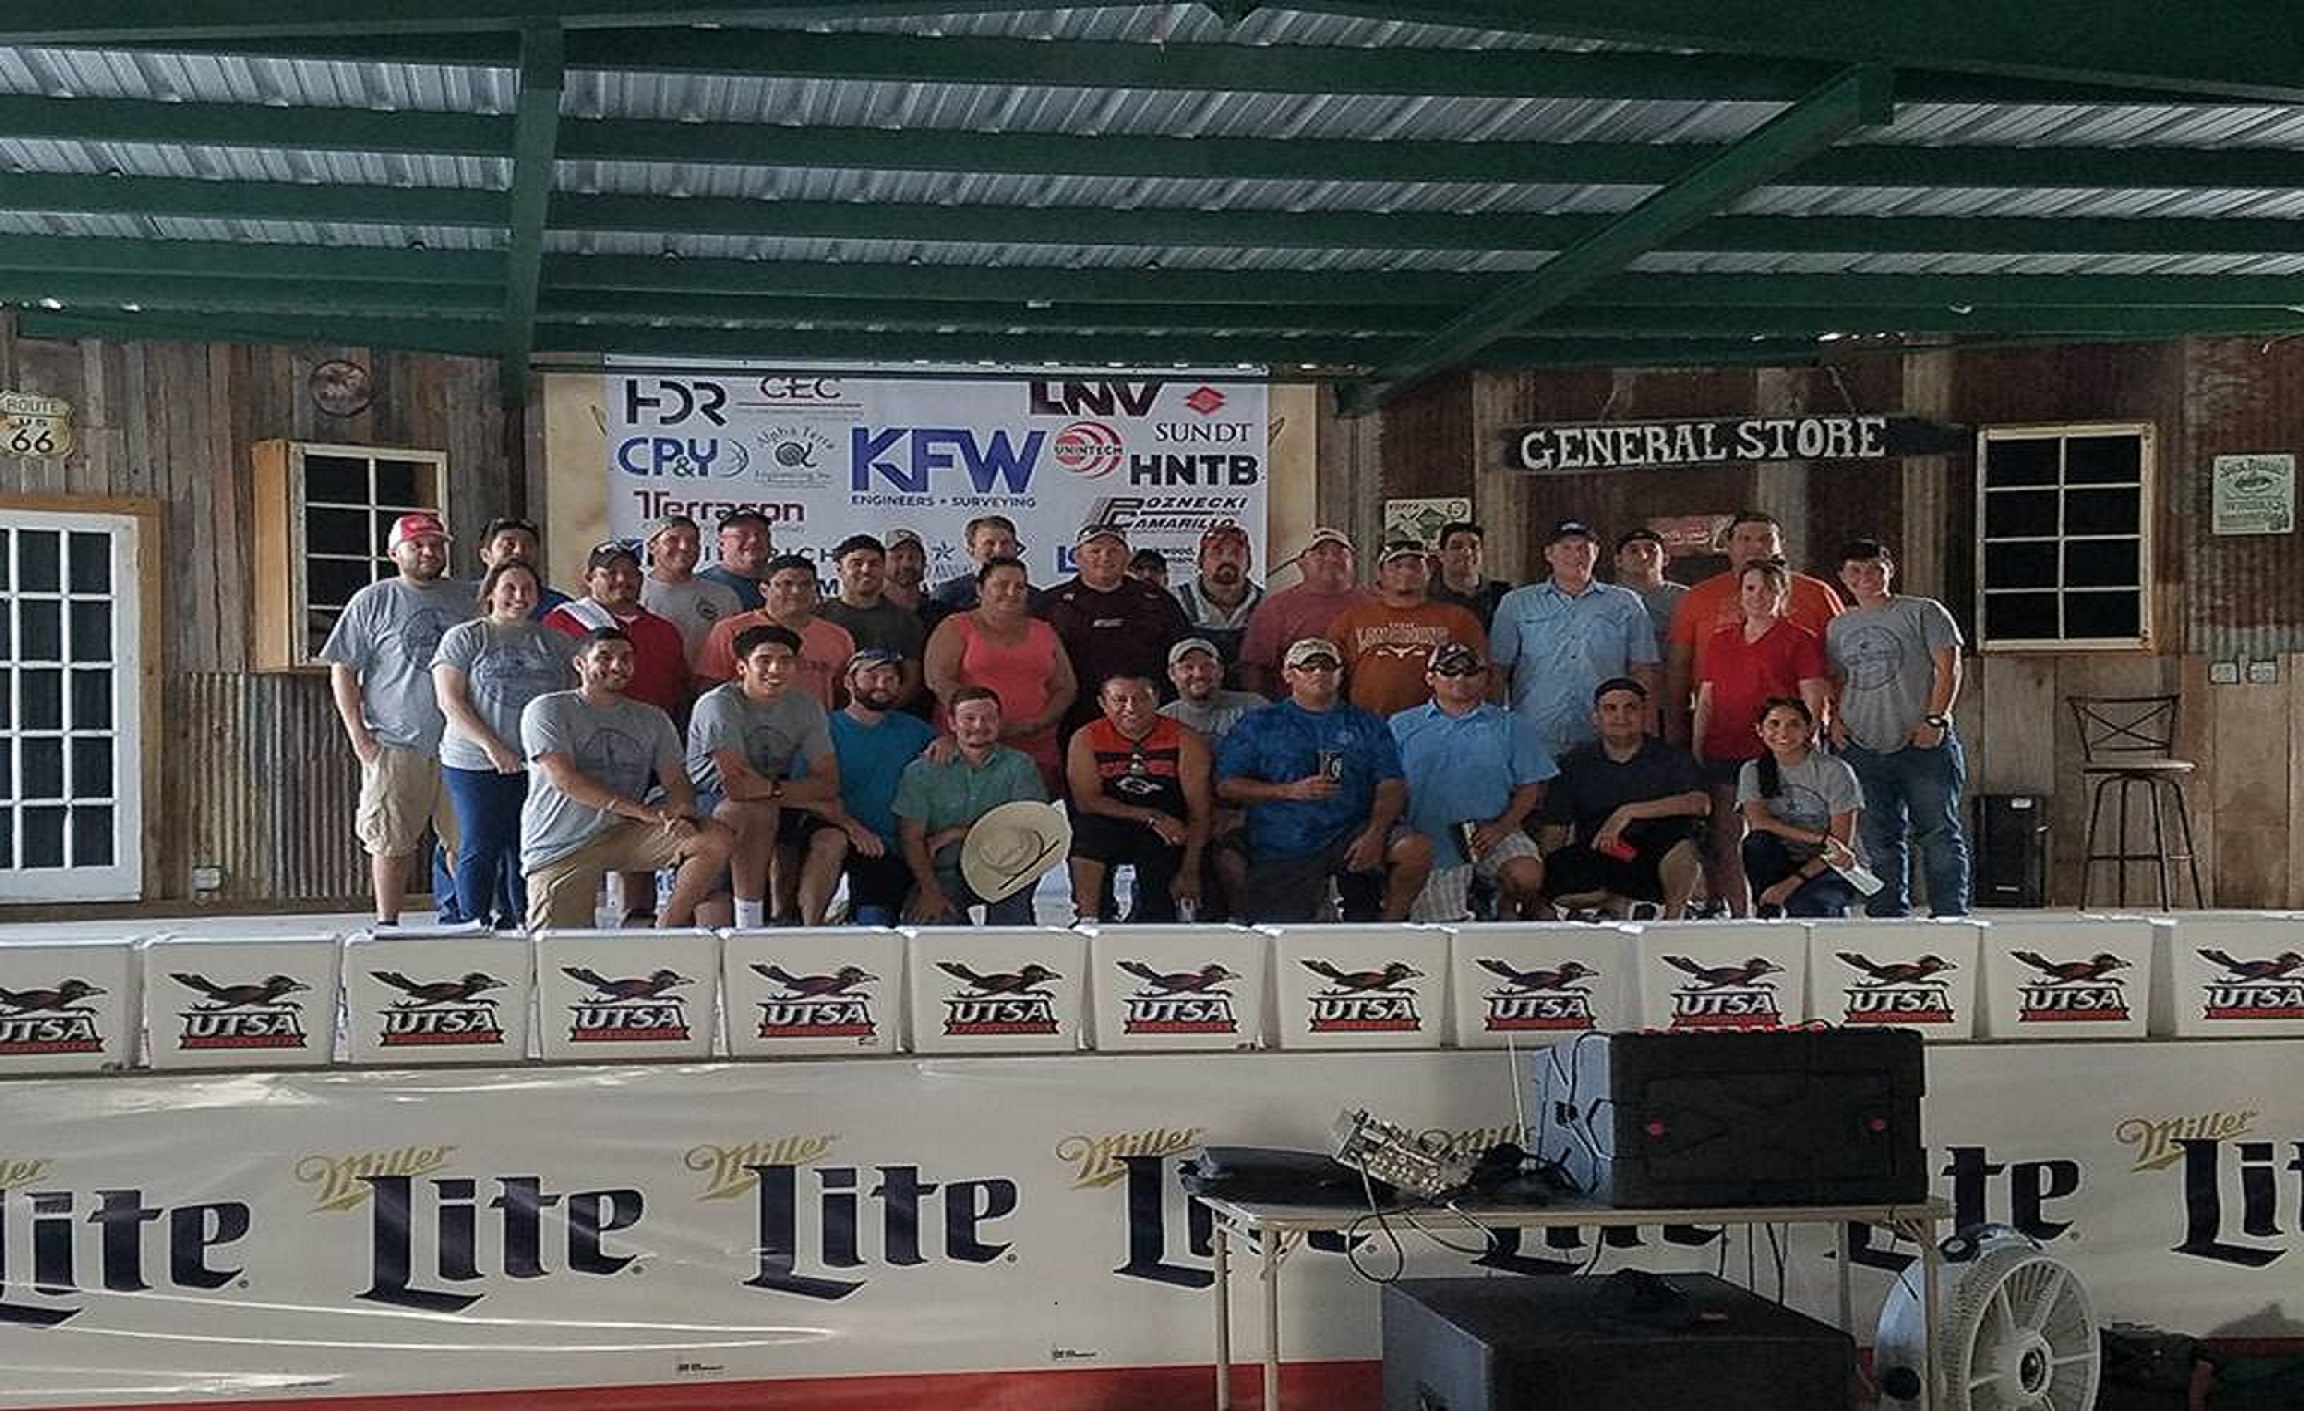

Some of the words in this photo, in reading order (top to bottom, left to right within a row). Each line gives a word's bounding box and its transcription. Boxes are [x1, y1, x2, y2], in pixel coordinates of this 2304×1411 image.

[6, 398, 59, 413] ROUTE
[626, 379, 728, 427] HDR
[1029, 381, 1163, 416] LNV
[12, 429, 54, 453] 66
[1156, 423, 1252, 442] SUNDT
[1521, 425, 1726, 470] GENERAL
[1736, 416, 1887, 460] STORE
[851, 427, 1046, 494] KFW
[1129, 455, 1258, 486] HNTB
[851, 495, 935, 506] ENGINEERS
[951, 496, 1036, 508] SURVEYING
[1492, 999, 1592, 1018] UTSA
[1680, 995, 1776, 1014] UTSA
[1853, 991, 1947, 1011] UTSA
[2028, 990, 2122, 1009] UTSA
[2213, 988, 2304, 1009] UTSA
[579, 1007, 683, 1028] UTSA
[767, 1004, 869, 1024] UTSA
[952, 1002, 1051, 1022] UTSA
[1133, 1001, 1231, 1021] UTSA
[1317, 1000, 1417, 1020] UTSA
[190, 1014, 298, 1036] UTSA
[387, 1011, 492, 1031] UTSA
[744, 1164, 1018, 1300] Lite
[355, 1175, 643, 1312] Lite
[0, 1189, 250, 1328] ite
